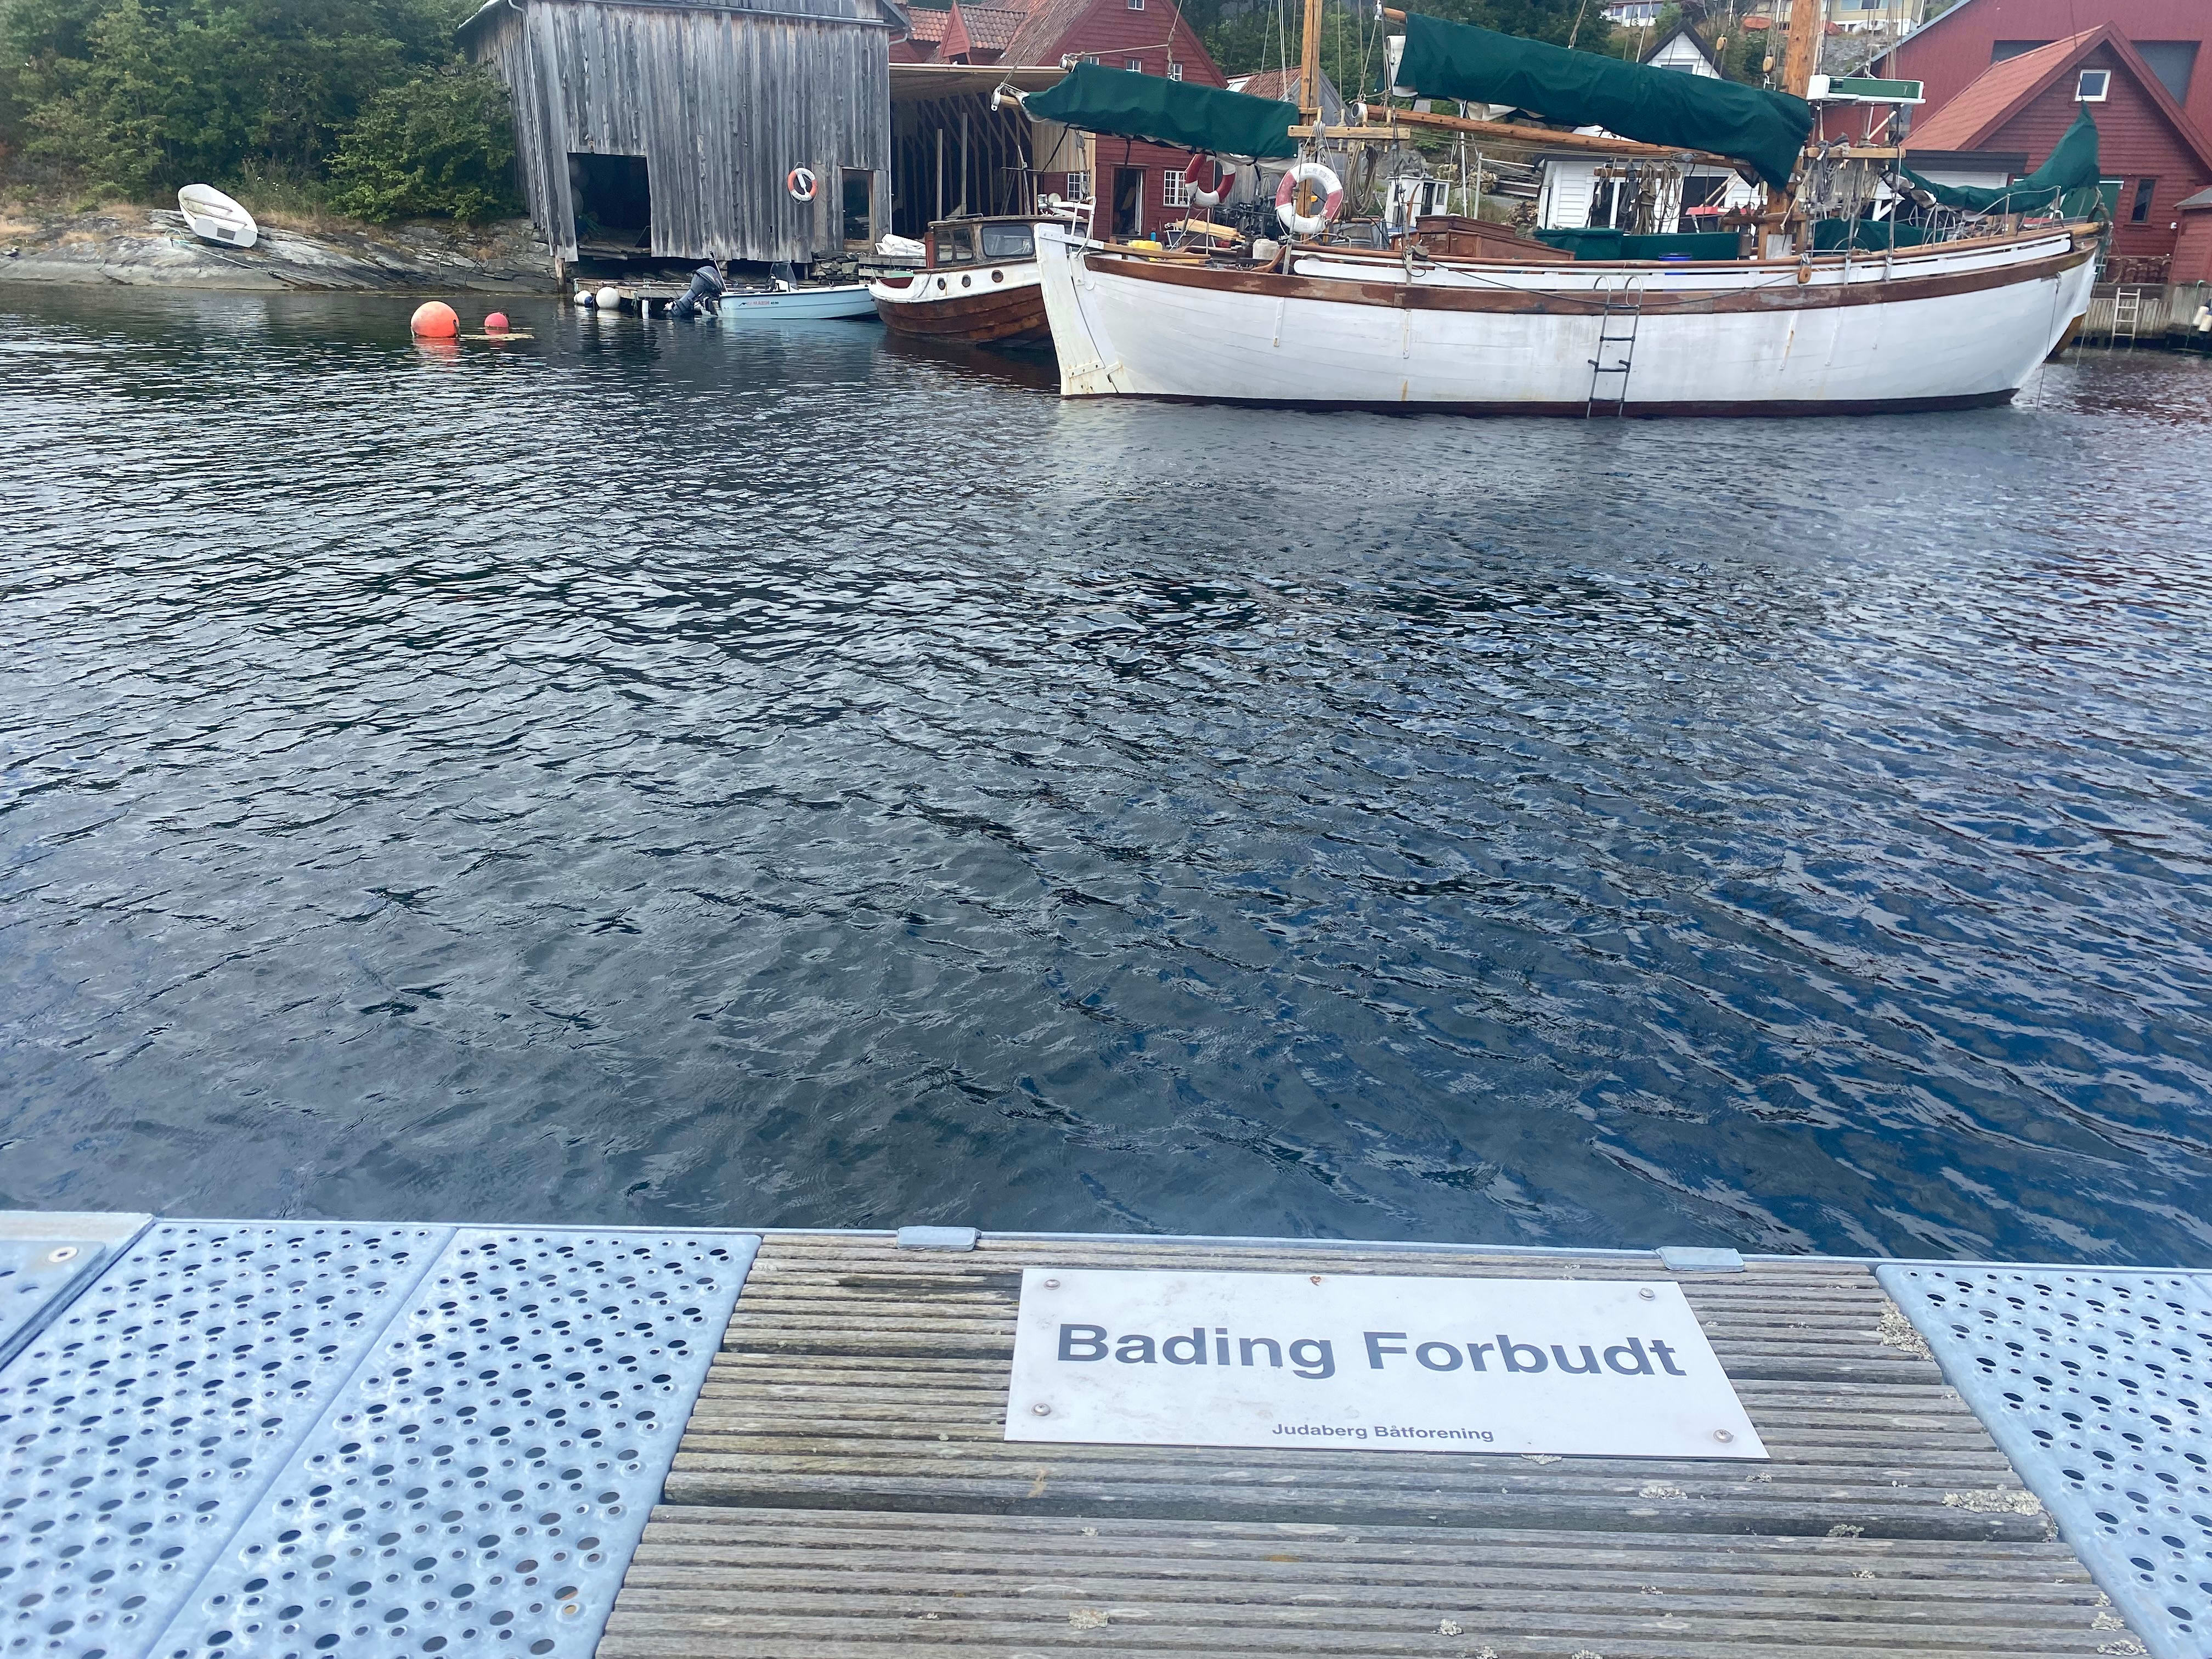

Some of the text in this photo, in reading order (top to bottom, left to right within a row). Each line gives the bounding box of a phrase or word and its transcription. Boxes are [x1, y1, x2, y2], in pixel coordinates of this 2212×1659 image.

[1057, 1323, 1687, 1380] Bading Forbudt
[1272, 1424, 1494, 1443] Judaberg Båtforening
